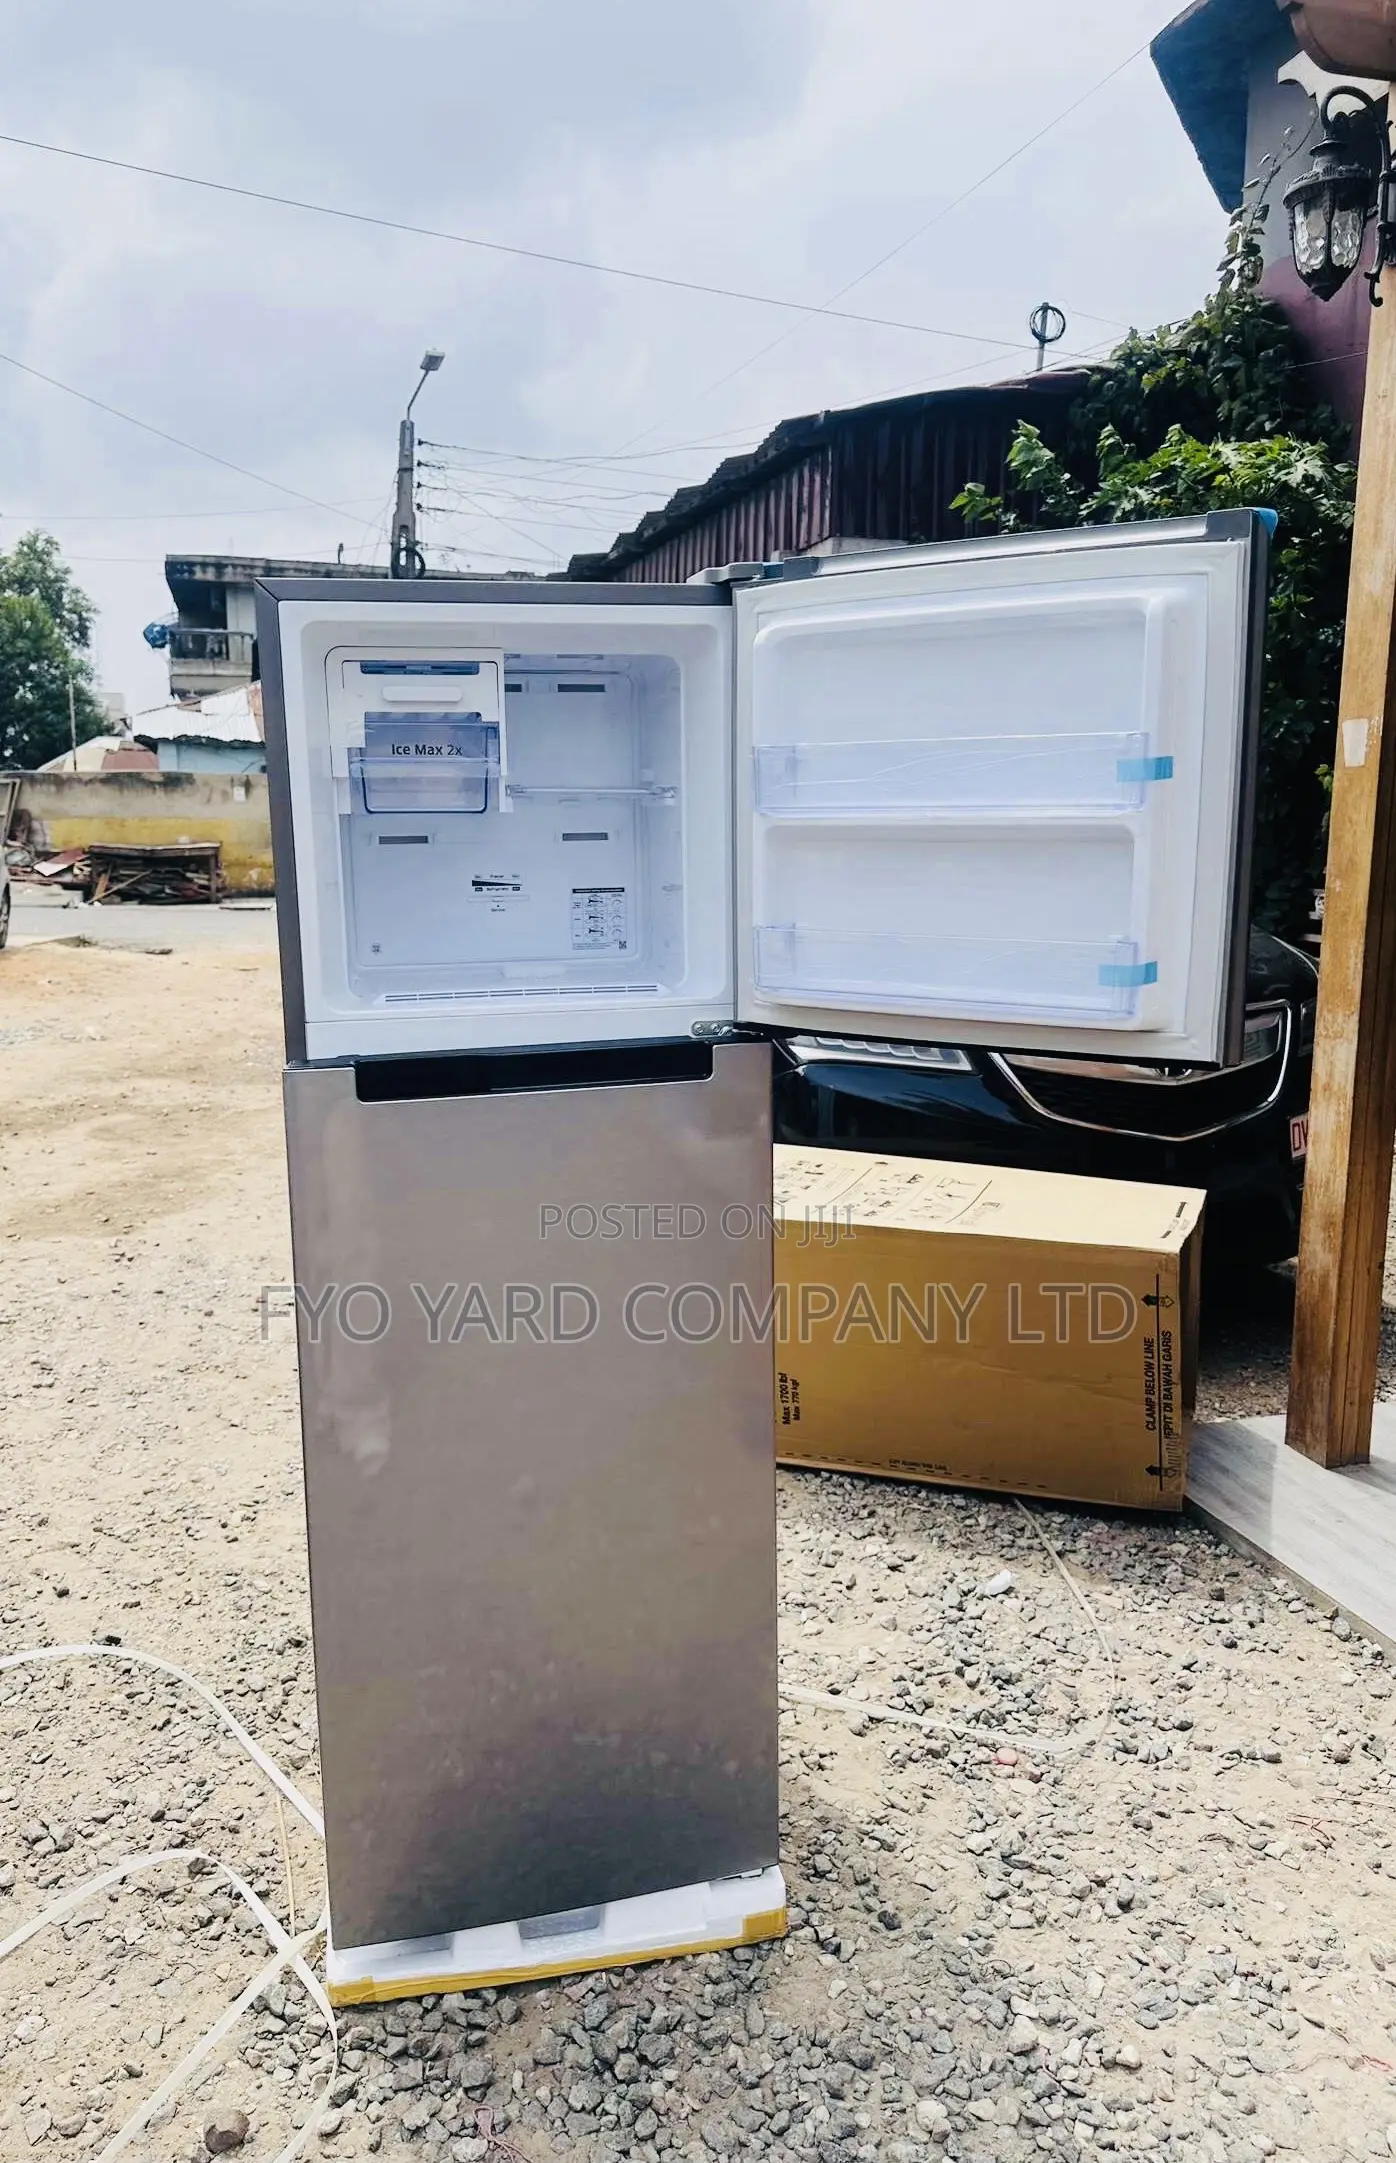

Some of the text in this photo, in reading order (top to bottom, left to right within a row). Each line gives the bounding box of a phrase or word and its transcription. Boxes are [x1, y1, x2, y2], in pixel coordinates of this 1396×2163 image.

[391, 743, 463, 756] Ice Max 2x
[1161, 1330, 1172, 1362] GARIS
[1143, 1336, 1157, 1431] CLAMP BELOW LINE
[1162, 1363, 1173, 1401] BAWAH
[782, 1406, 791, 1425] Max
[1163, 1403, 1173, 1413] DI
